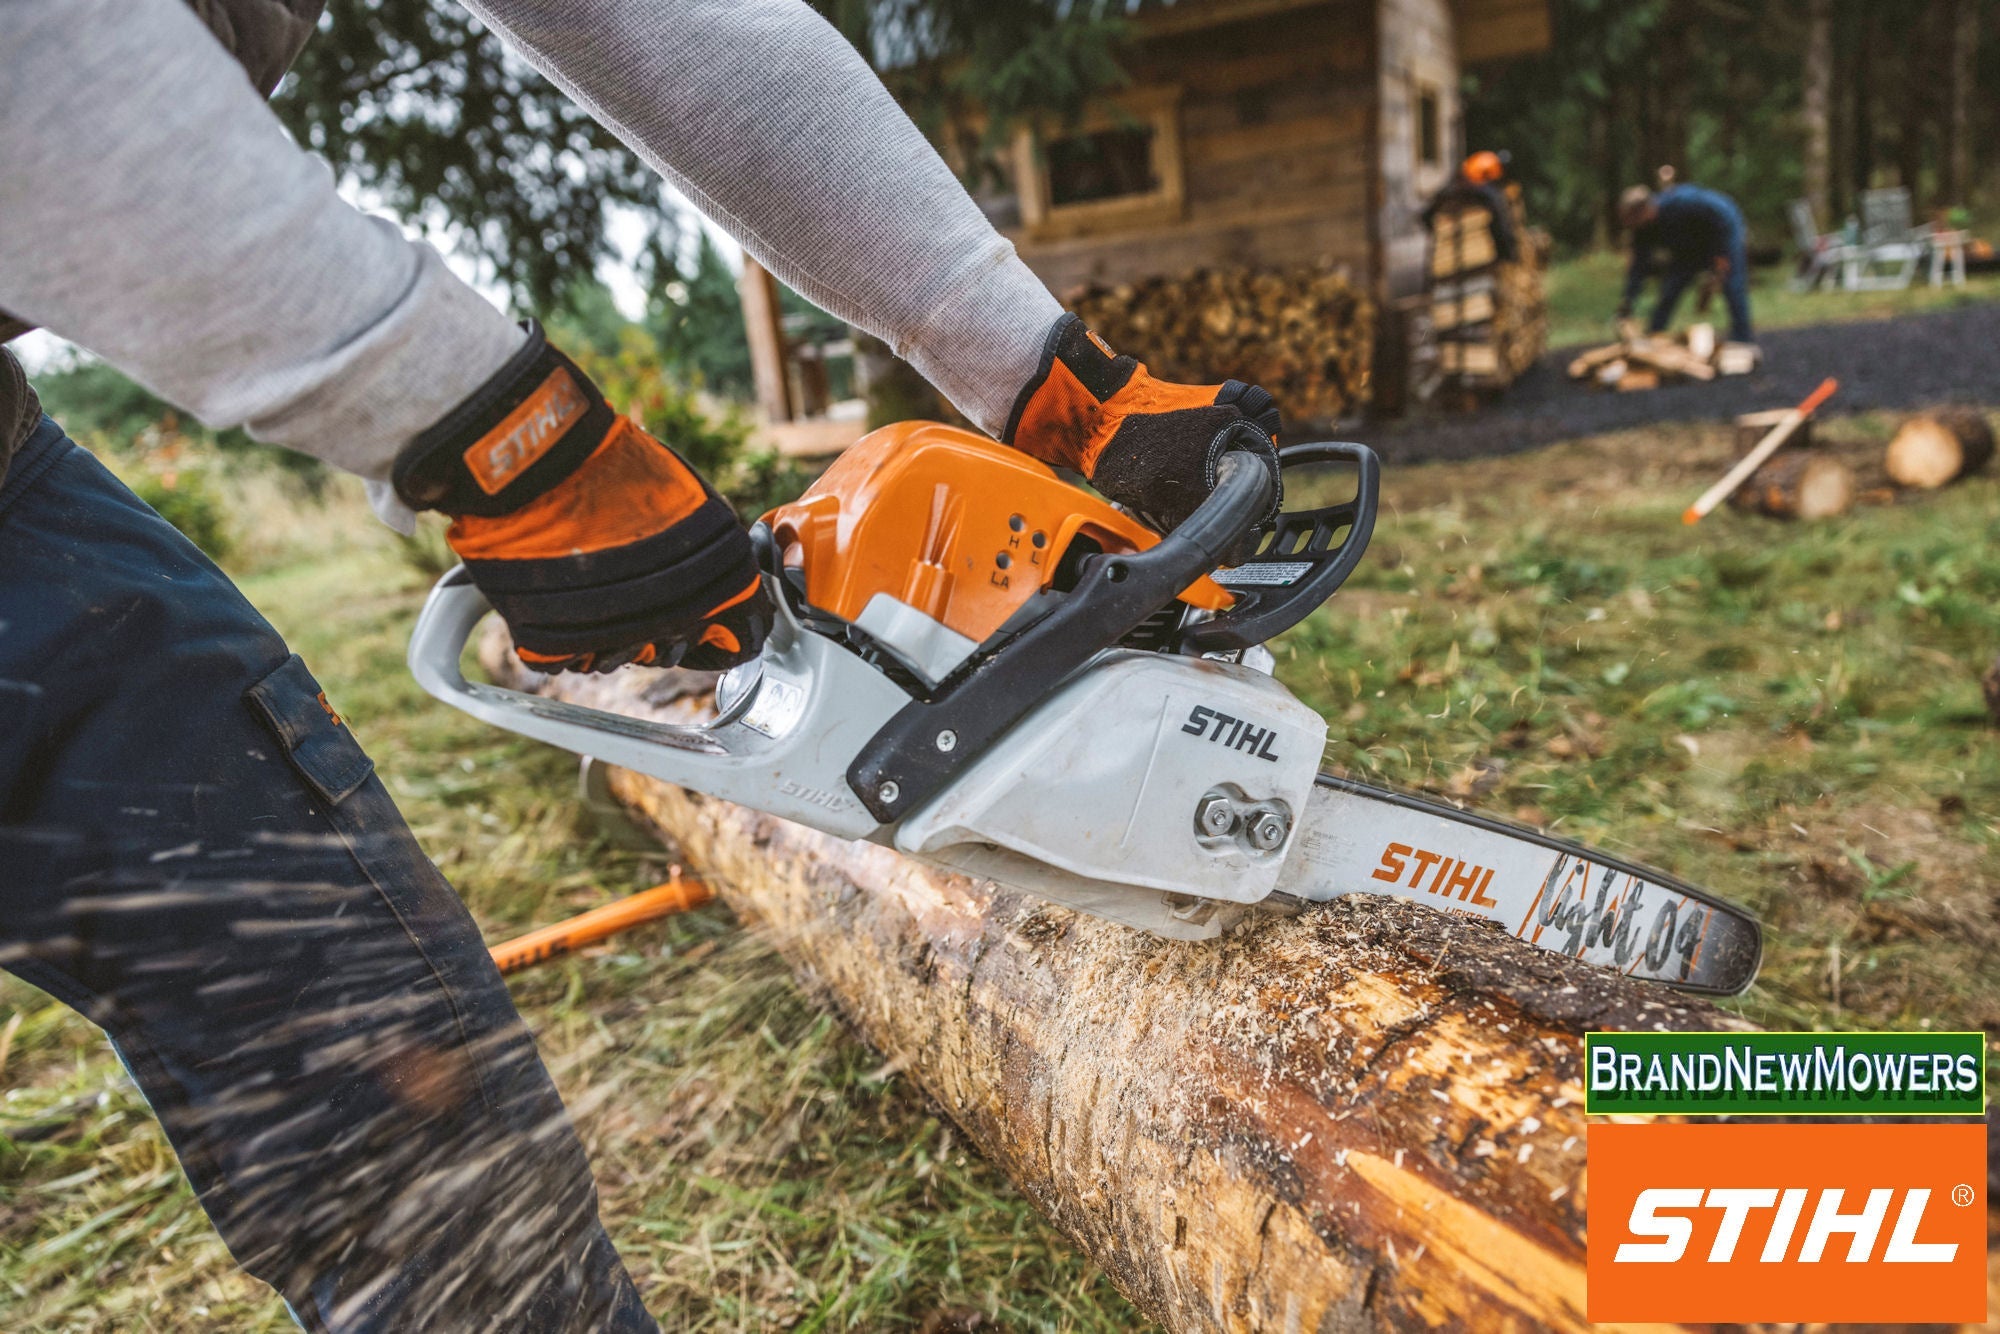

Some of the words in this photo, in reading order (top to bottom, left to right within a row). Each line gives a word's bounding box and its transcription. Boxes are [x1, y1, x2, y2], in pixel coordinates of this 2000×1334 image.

[489, 391, 575, 479] STIHL
[1009, 535, 1020, 549] H
[1031, 551, 1039, 565] L
[991, 571, 1009, 590] LA
[1181, 705, 1279, 762] STIHL
[1371, 842, 1497, 909] STIHL
